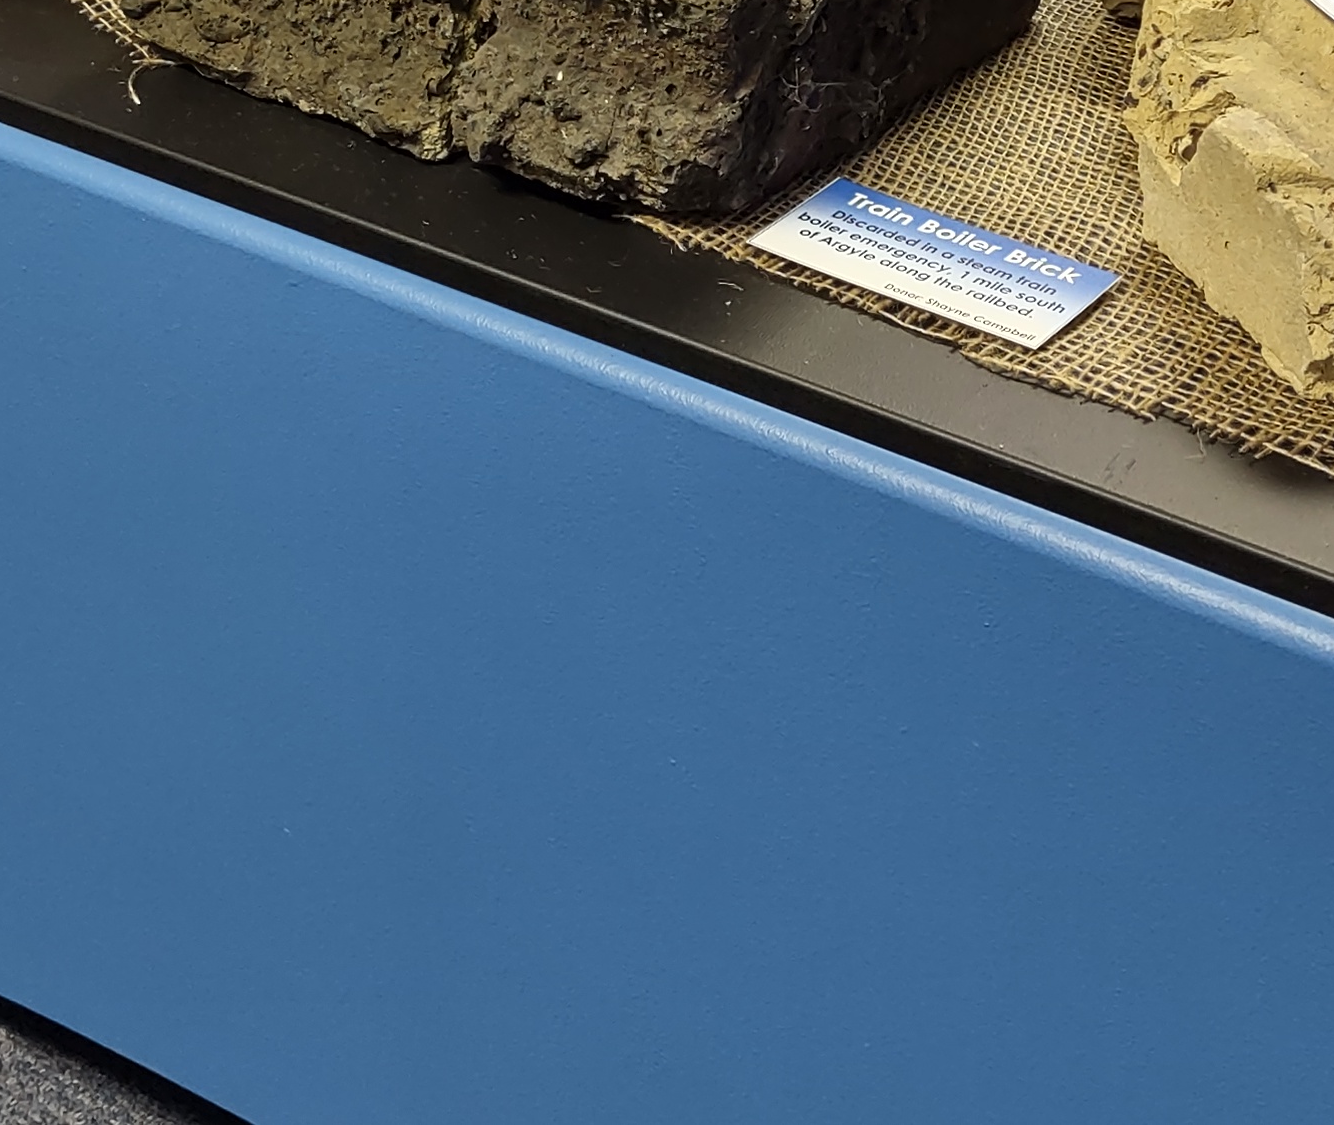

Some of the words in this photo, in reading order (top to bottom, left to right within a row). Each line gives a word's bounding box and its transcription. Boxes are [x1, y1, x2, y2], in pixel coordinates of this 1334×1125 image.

[797, 211, 849, 235] boiler
[850, 231, 951, 275] emergency,
[961, 269, 969, 280] 1
[971, 274, 1013, 296] mile
[1015, 290, 1067, 315] south
[799, 227, 821, 243] of
[819, 235, 878, 265] Argyle
[879, 257, 930, 283] along
[933, 275, 963, 294] the
[966, 287, 1034, 319] railbed.
[831, 209, 920, 247] Discarded
[921, 241, 937, 255] in
[941, 251, 956, 262] a
[957, 255, 1013, 283] steam
[1015, 275, 1058, 296] train
[846, 192, 913, 227] Train
[917, 219, 1002, 257] Boiler
[1003, 248, 1084, 286] Brick
[924, 296, 971, 319] Shayne
[973, 313, 1038, 342] Campbell
